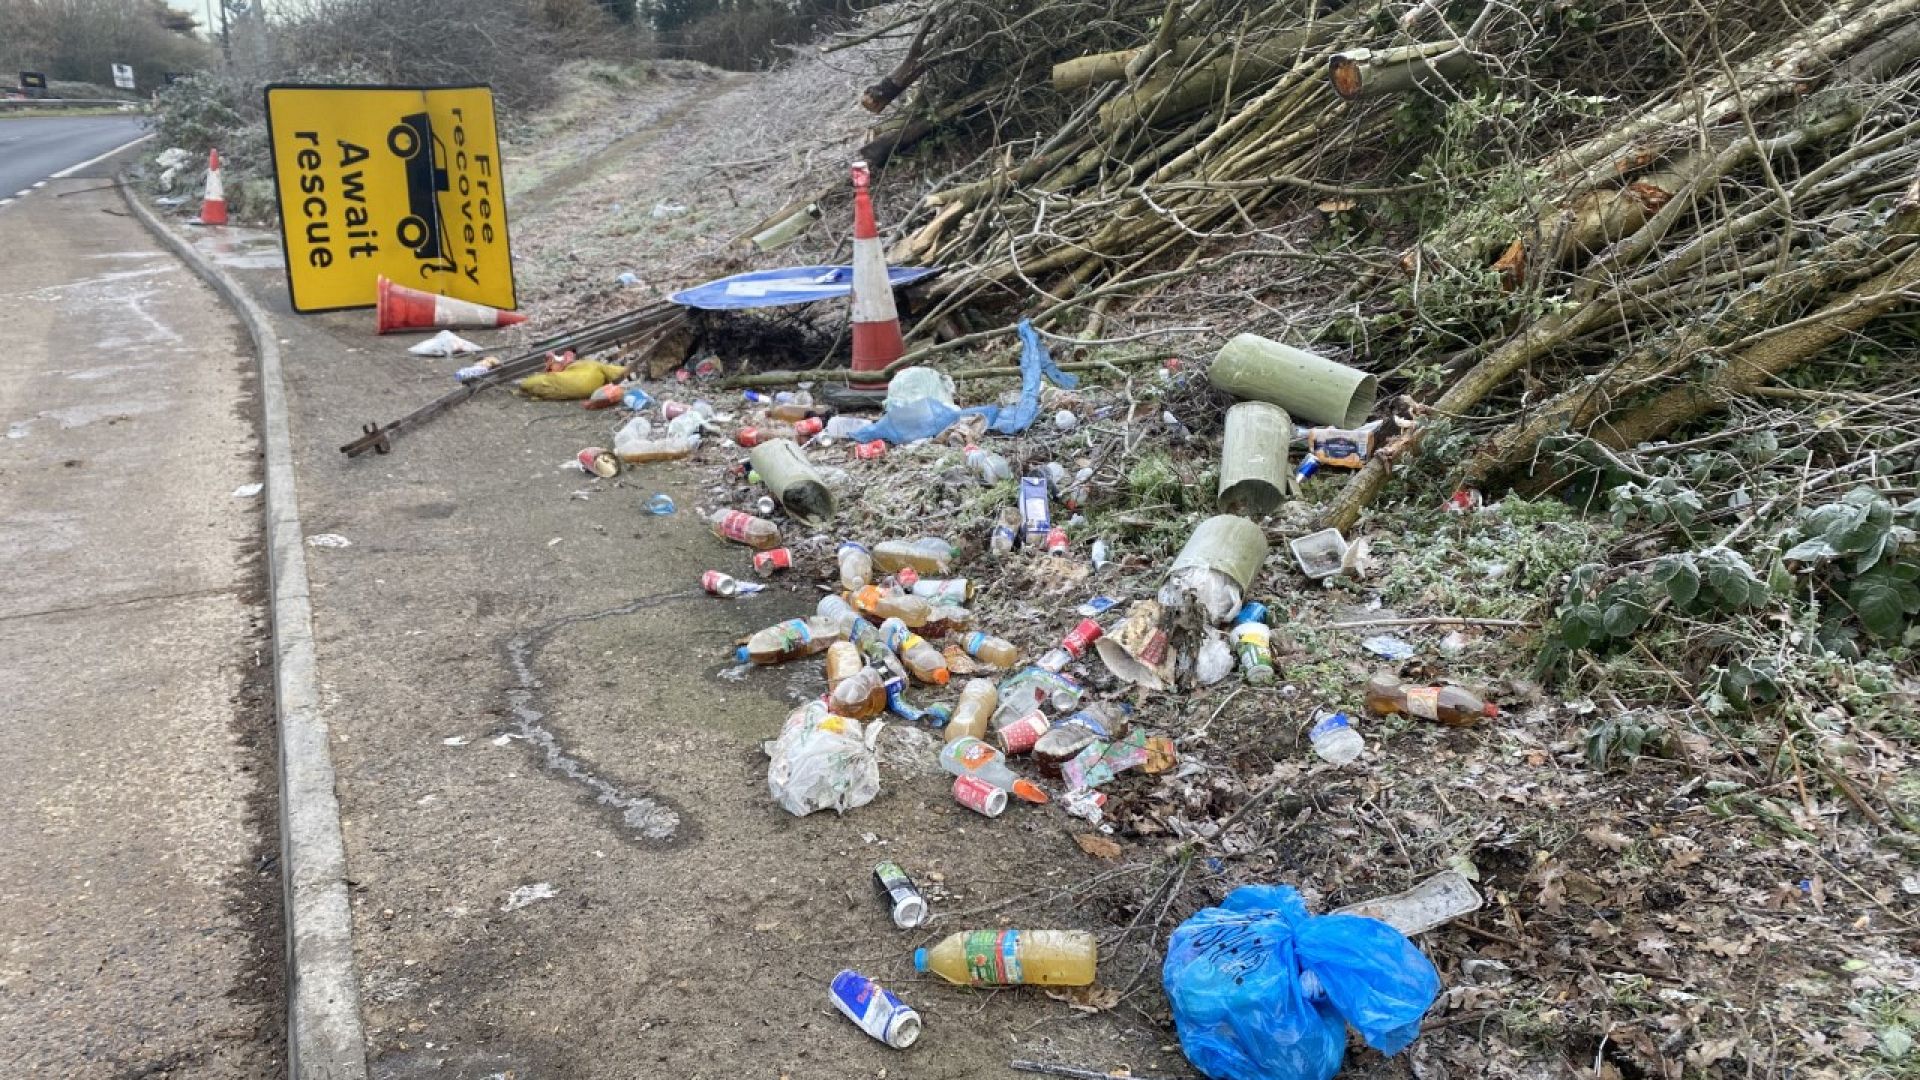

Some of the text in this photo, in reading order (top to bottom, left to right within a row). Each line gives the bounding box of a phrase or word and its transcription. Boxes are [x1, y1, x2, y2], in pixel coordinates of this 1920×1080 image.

[295, 131, 334, 268] rescue
[336, 139, 379, 259] Await
[451, 108, 480, 286] recovery
[474, 154, 494, 244] Free
